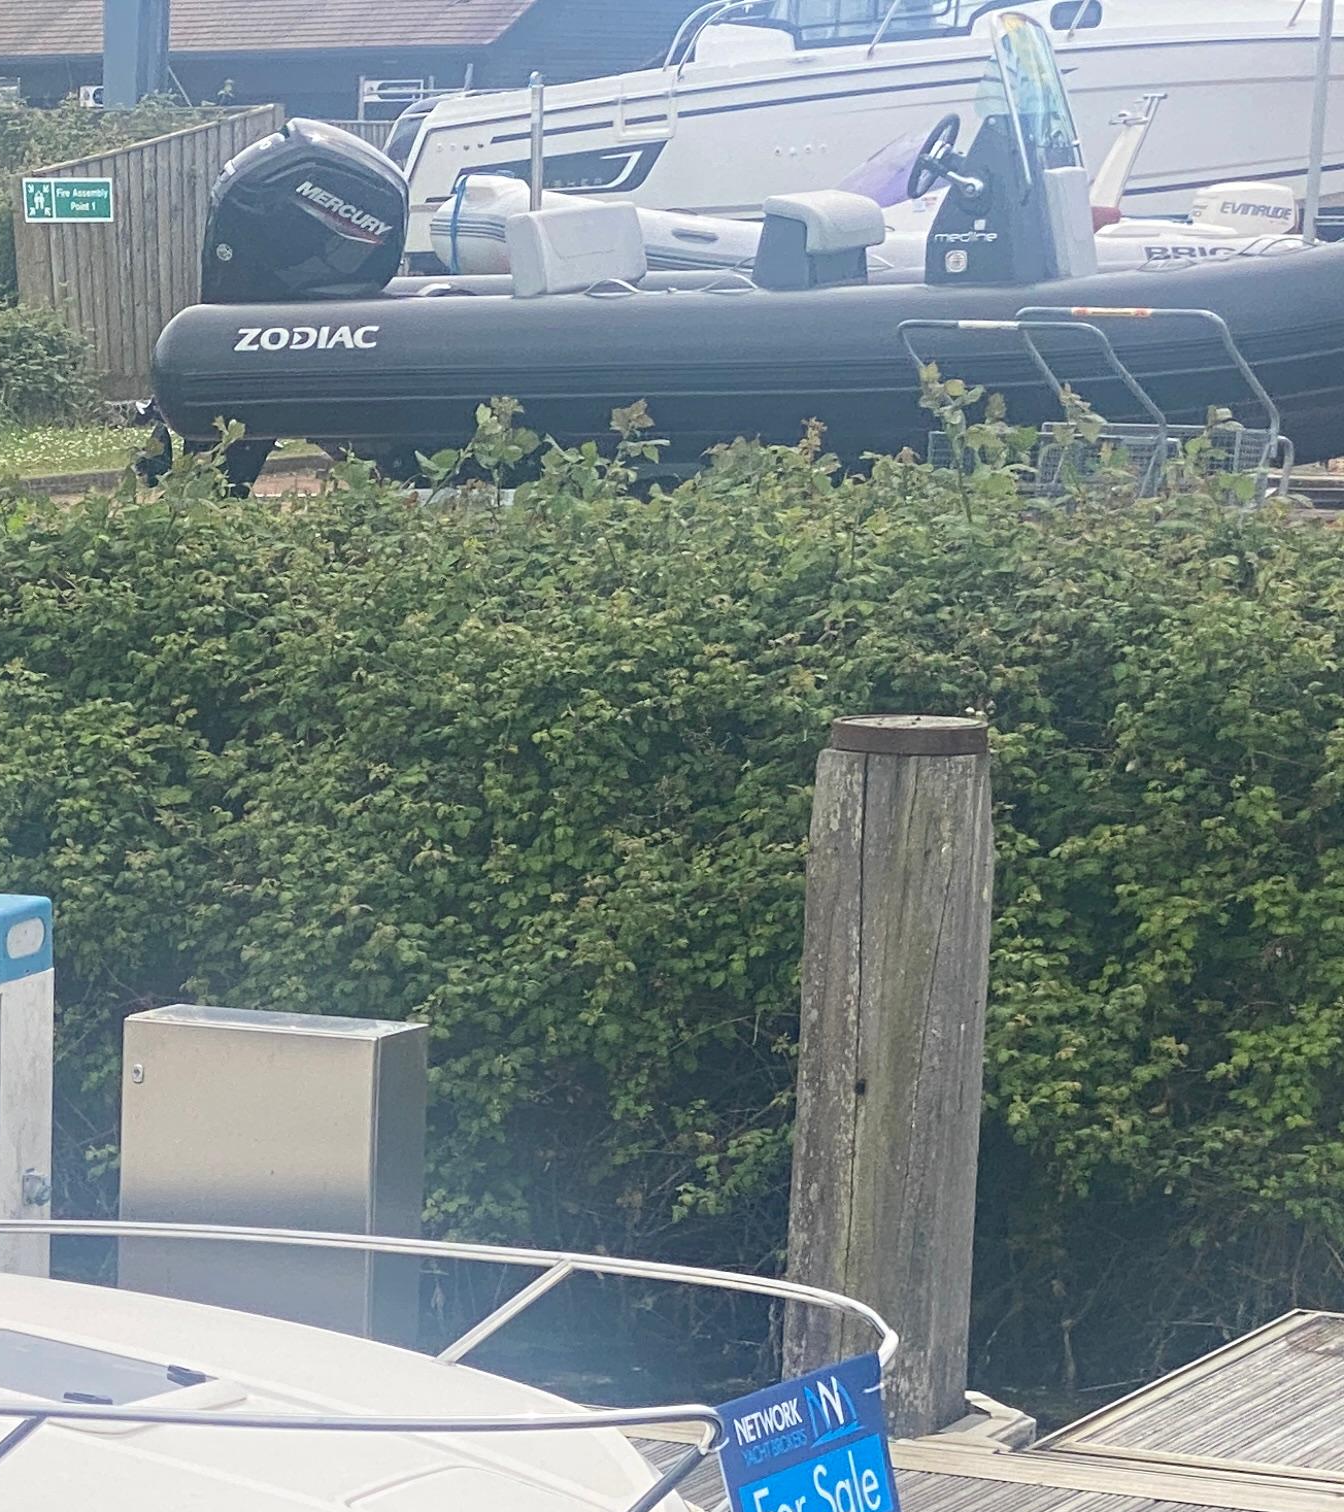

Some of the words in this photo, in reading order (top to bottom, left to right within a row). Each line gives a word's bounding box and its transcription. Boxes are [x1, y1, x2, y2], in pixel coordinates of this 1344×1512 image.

[55, 187, 71, 198] Fire
[72, 187, 109, 199] Assembly
[70, 201, 90, 211] Point
[296, 180, 394, 236] MERCURY
[1220, 201, 1293, 220] EVINRUDE
[233, 325, 381, 353] ZODIAC
[733, 1397, 803, 1447] NETWORK
